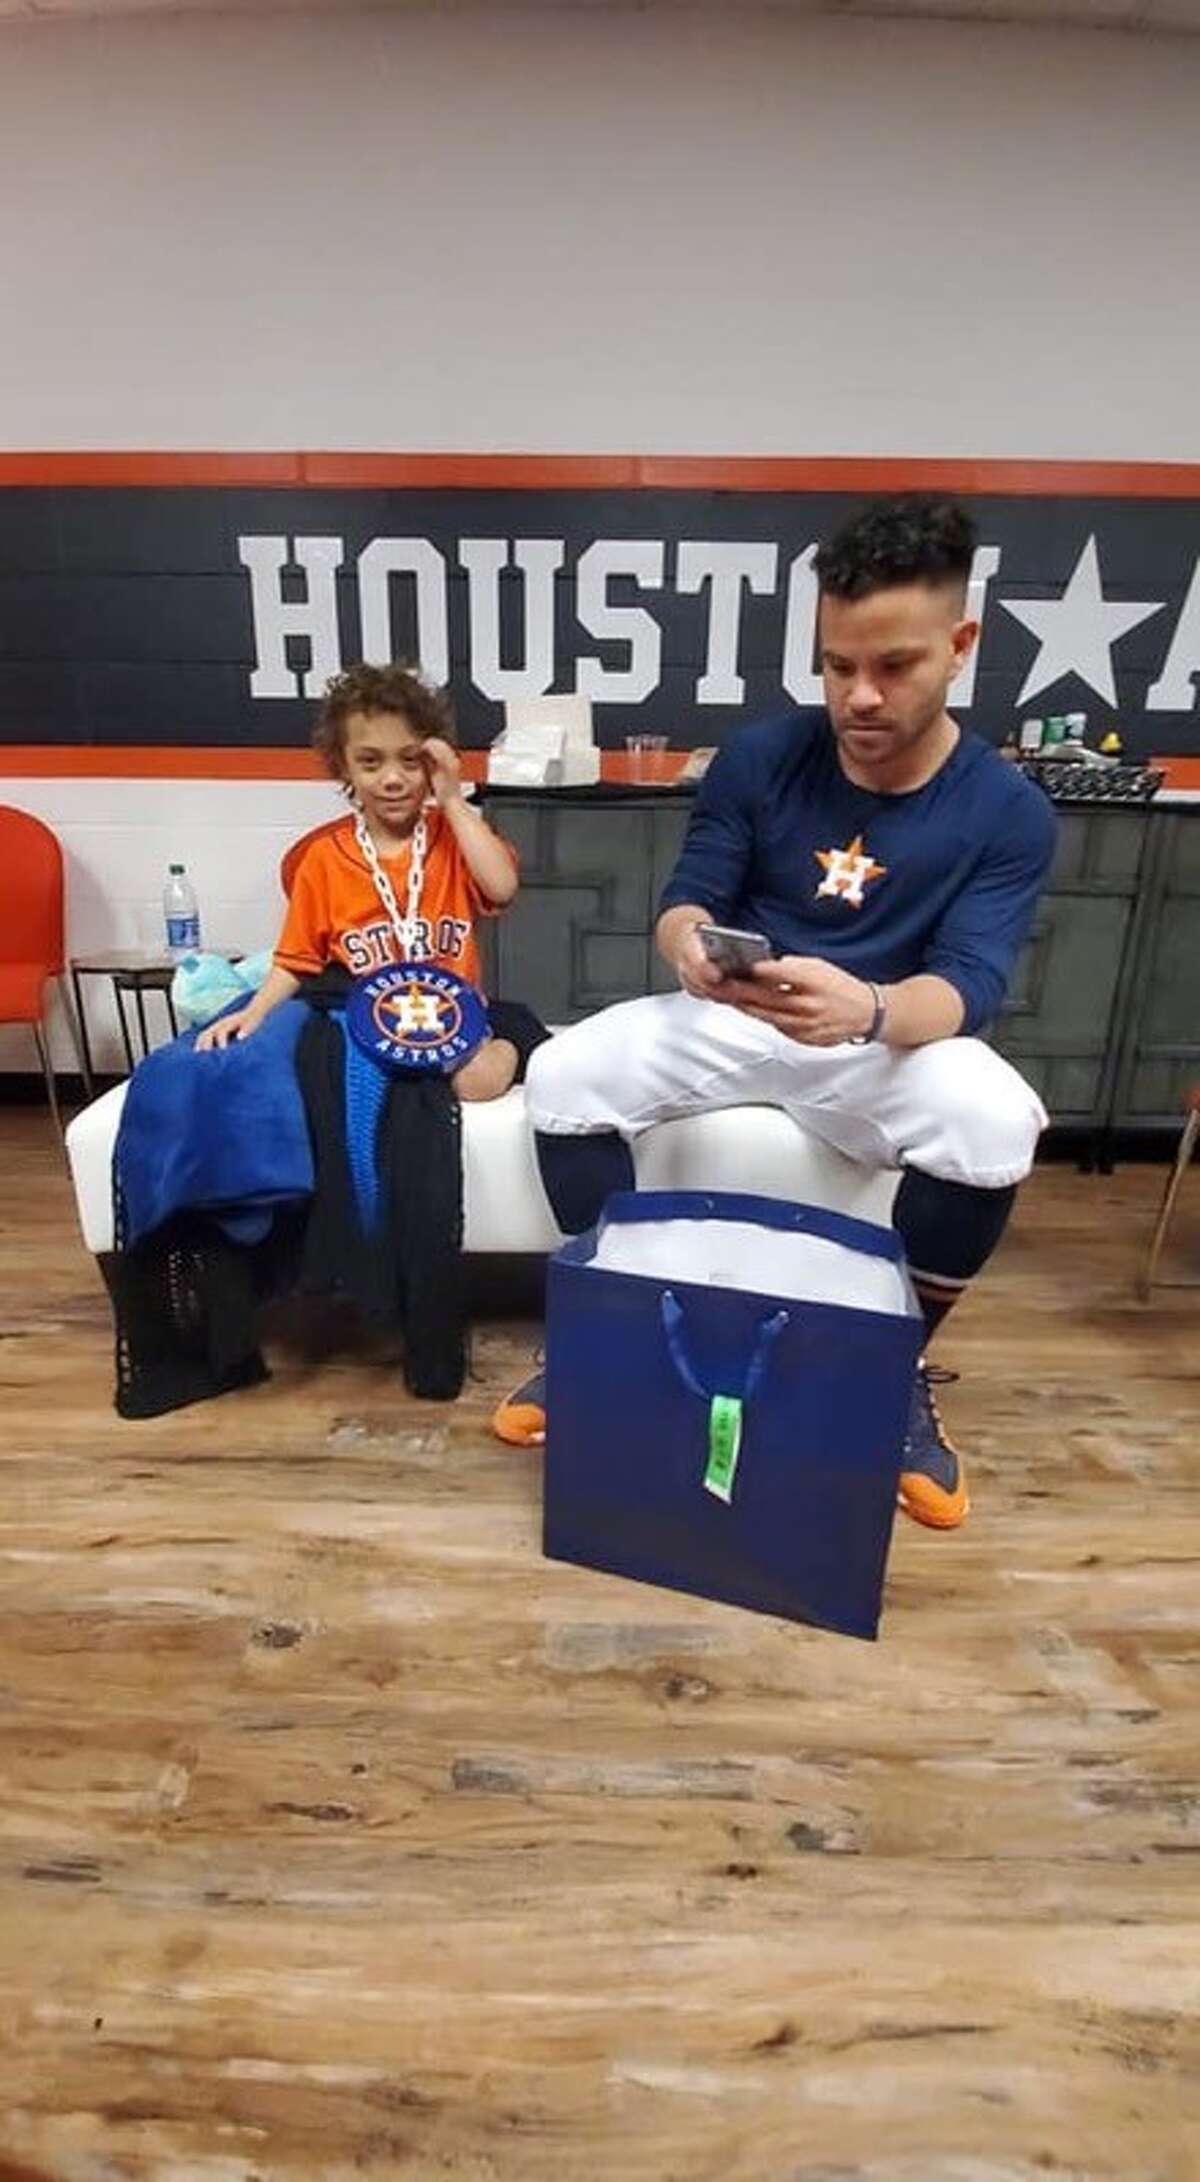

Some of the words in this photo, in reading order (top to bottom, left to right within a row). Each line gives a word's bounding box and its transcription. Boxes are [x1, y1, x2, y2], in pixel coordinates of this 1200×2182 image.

[237, 535, 1001, 708] HOUST
[364, 970, 461, 997] HOUSTON
[375, 1035, 469, 1062] ASTROS
